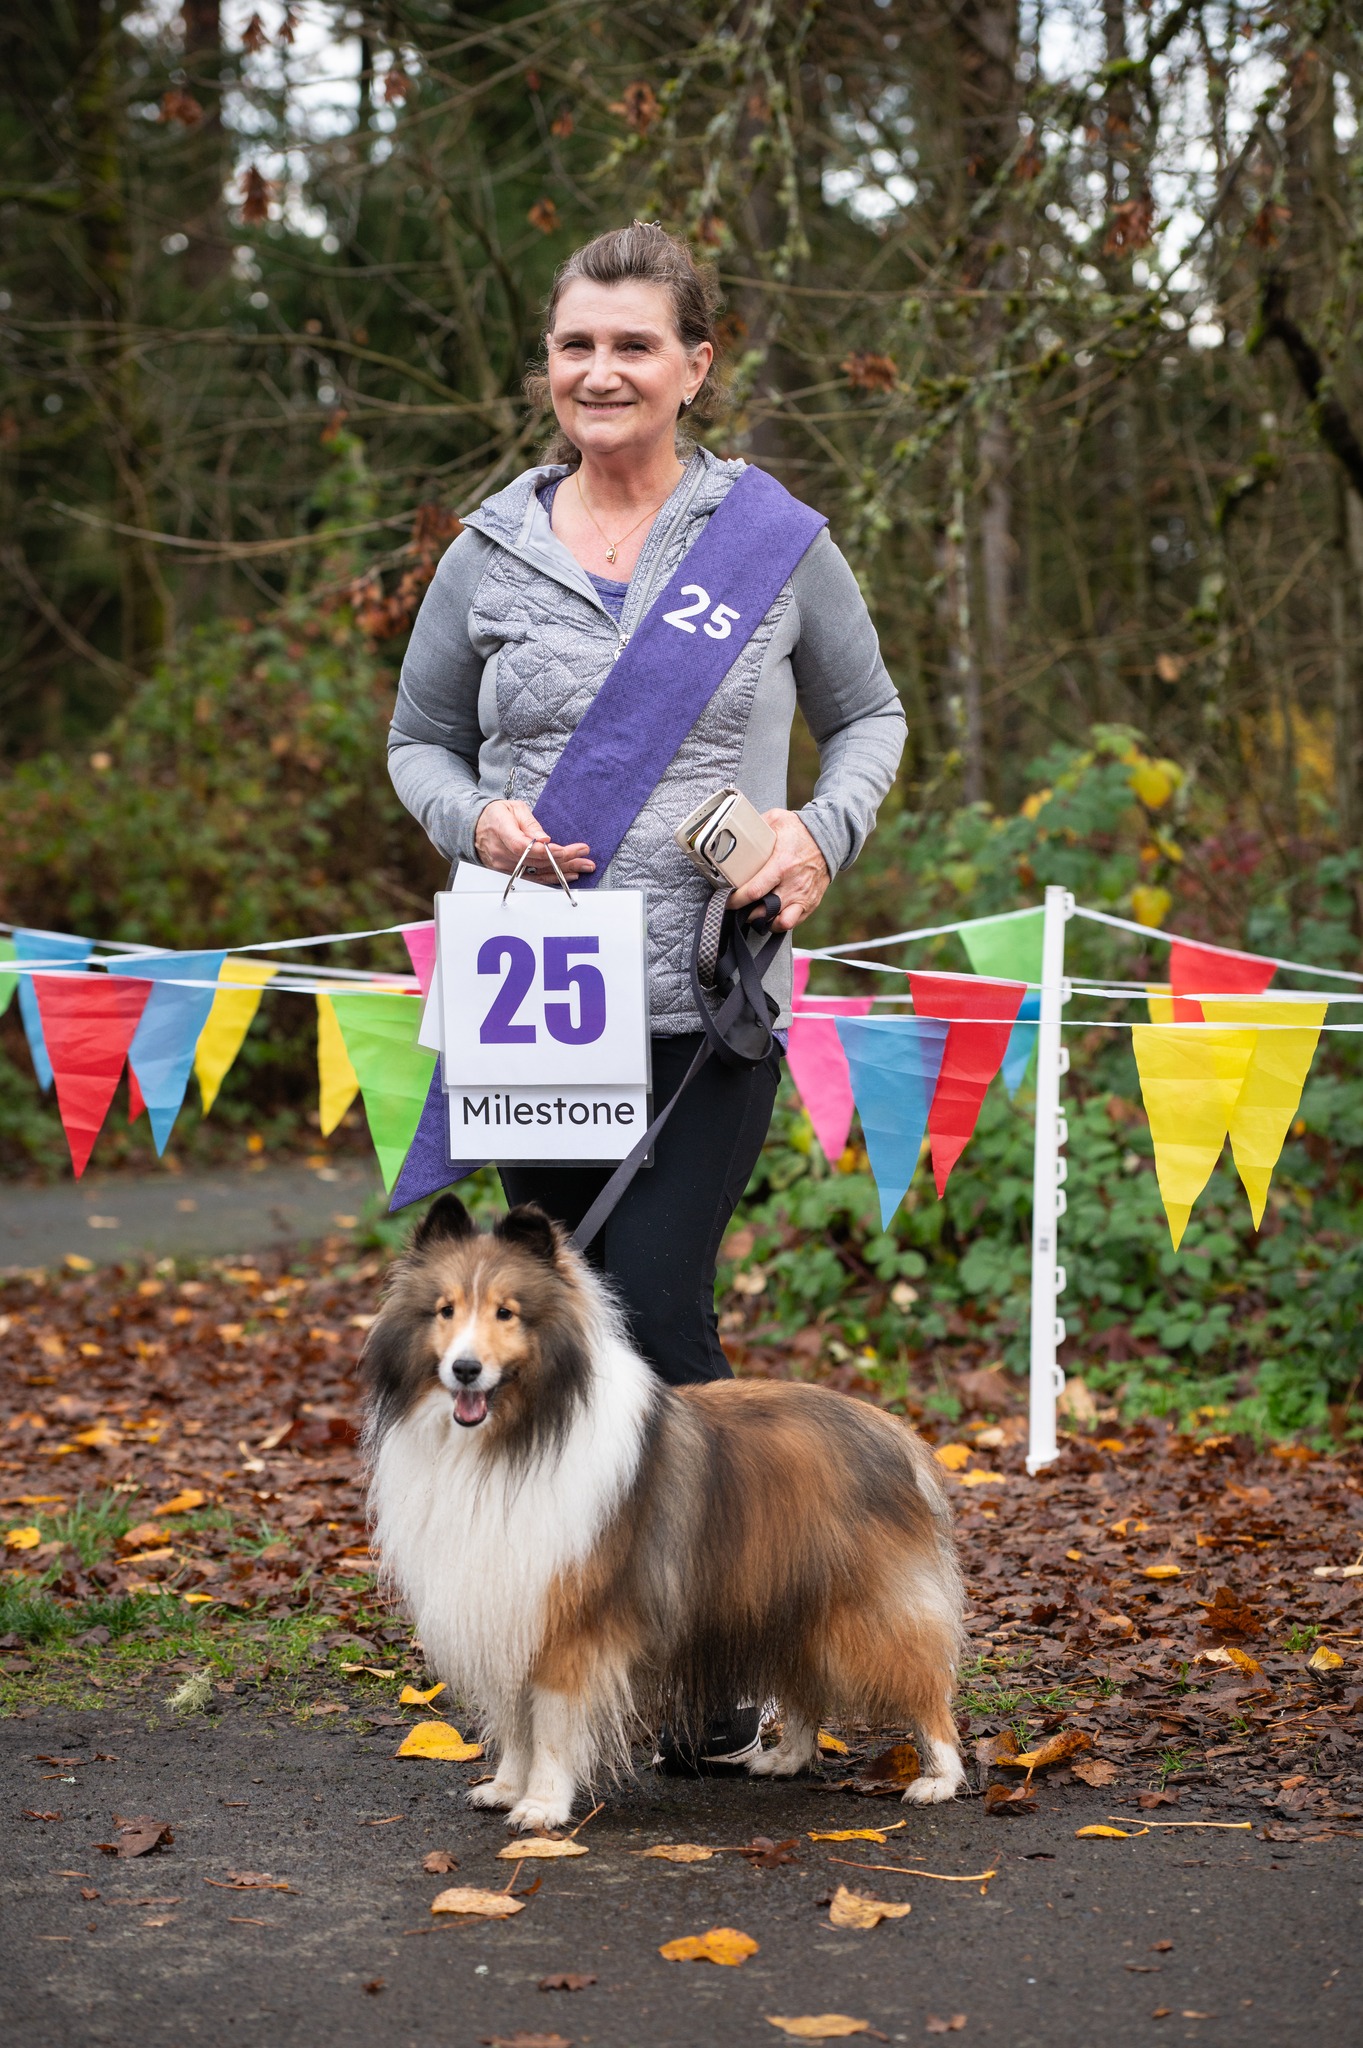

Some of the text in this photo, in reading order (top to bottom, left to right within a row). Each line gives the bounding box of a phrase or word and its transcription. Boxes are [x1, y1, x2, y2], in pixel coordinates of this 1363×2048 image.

[662, 584, 741, 640] 25
[477, 935, 607, 1046] 25
[462, 1094, 635, 1126] Milestone
